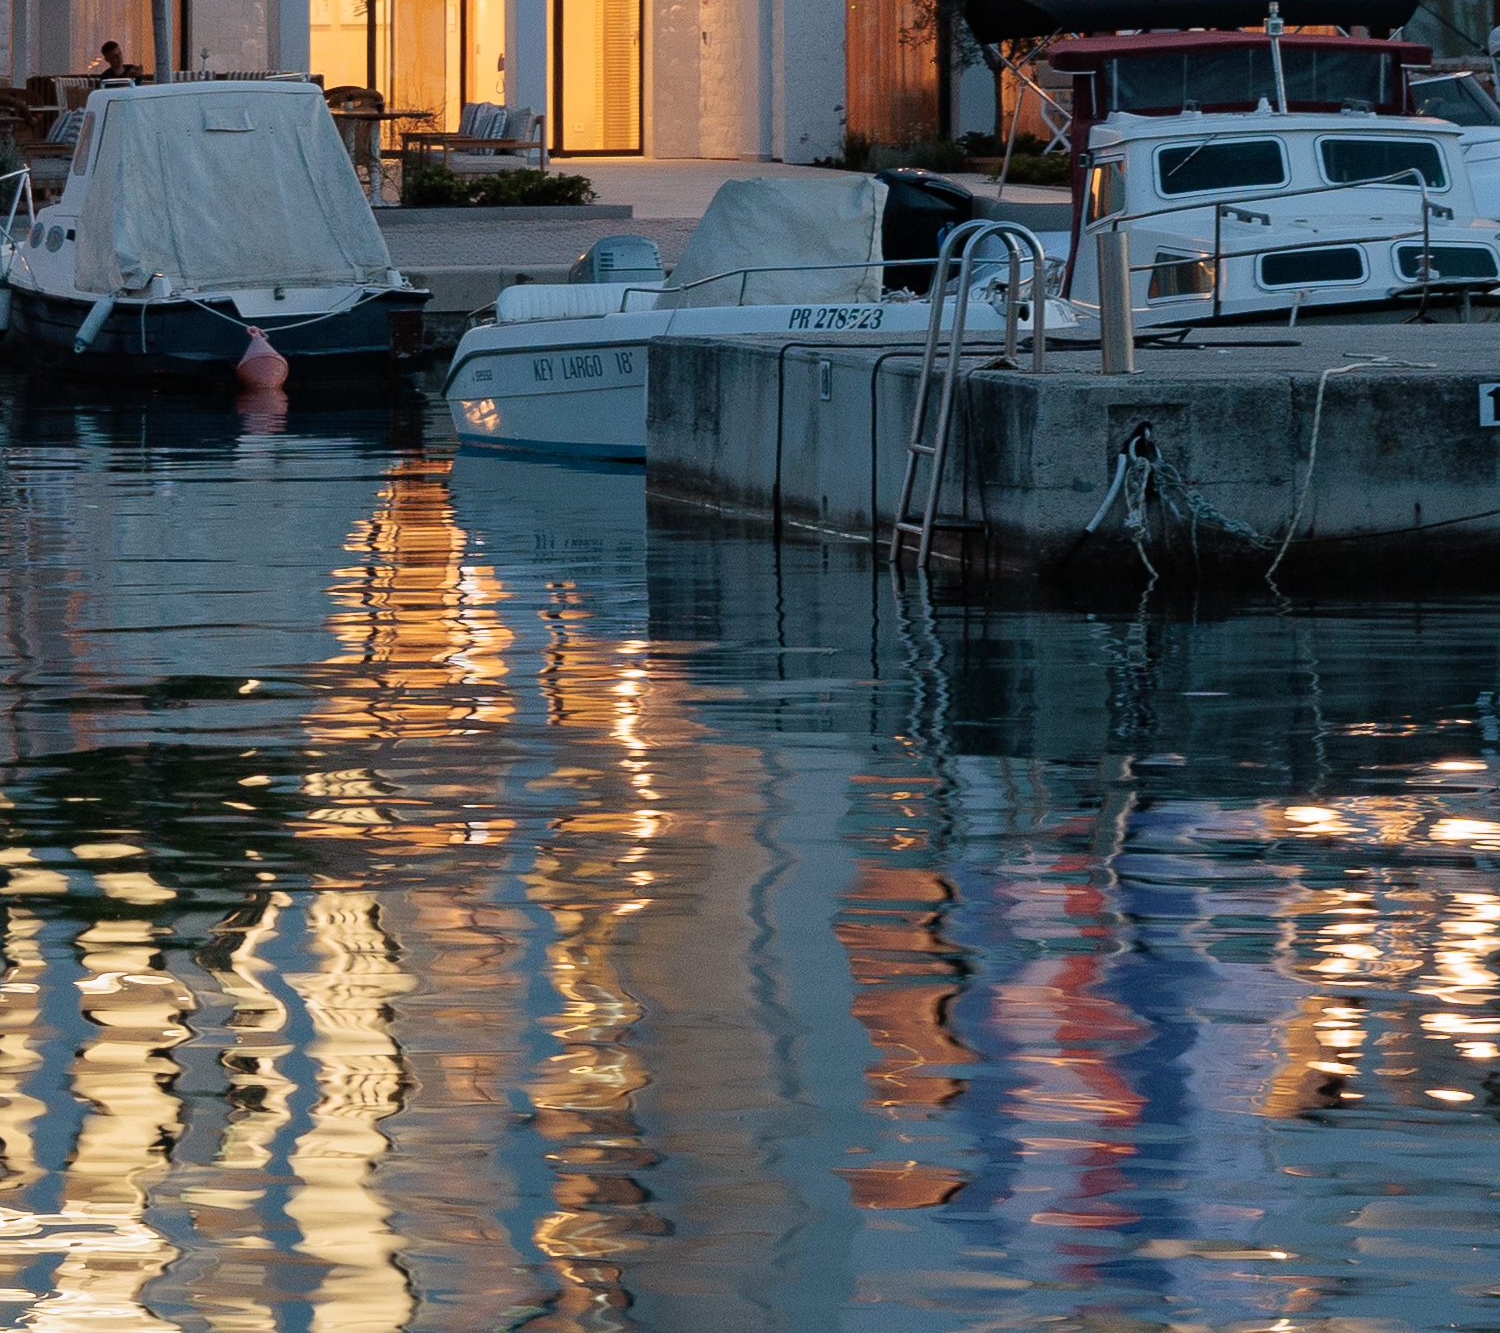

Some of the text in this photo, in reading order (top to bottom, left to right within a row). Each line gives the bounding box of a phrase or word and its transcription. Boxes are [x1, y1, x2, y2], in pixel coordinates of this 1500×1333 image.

[788, 307, 884, 330] PR 278523
[533, 358, 554, 381] KEY
[562, 354, 603, 379] LARGO
